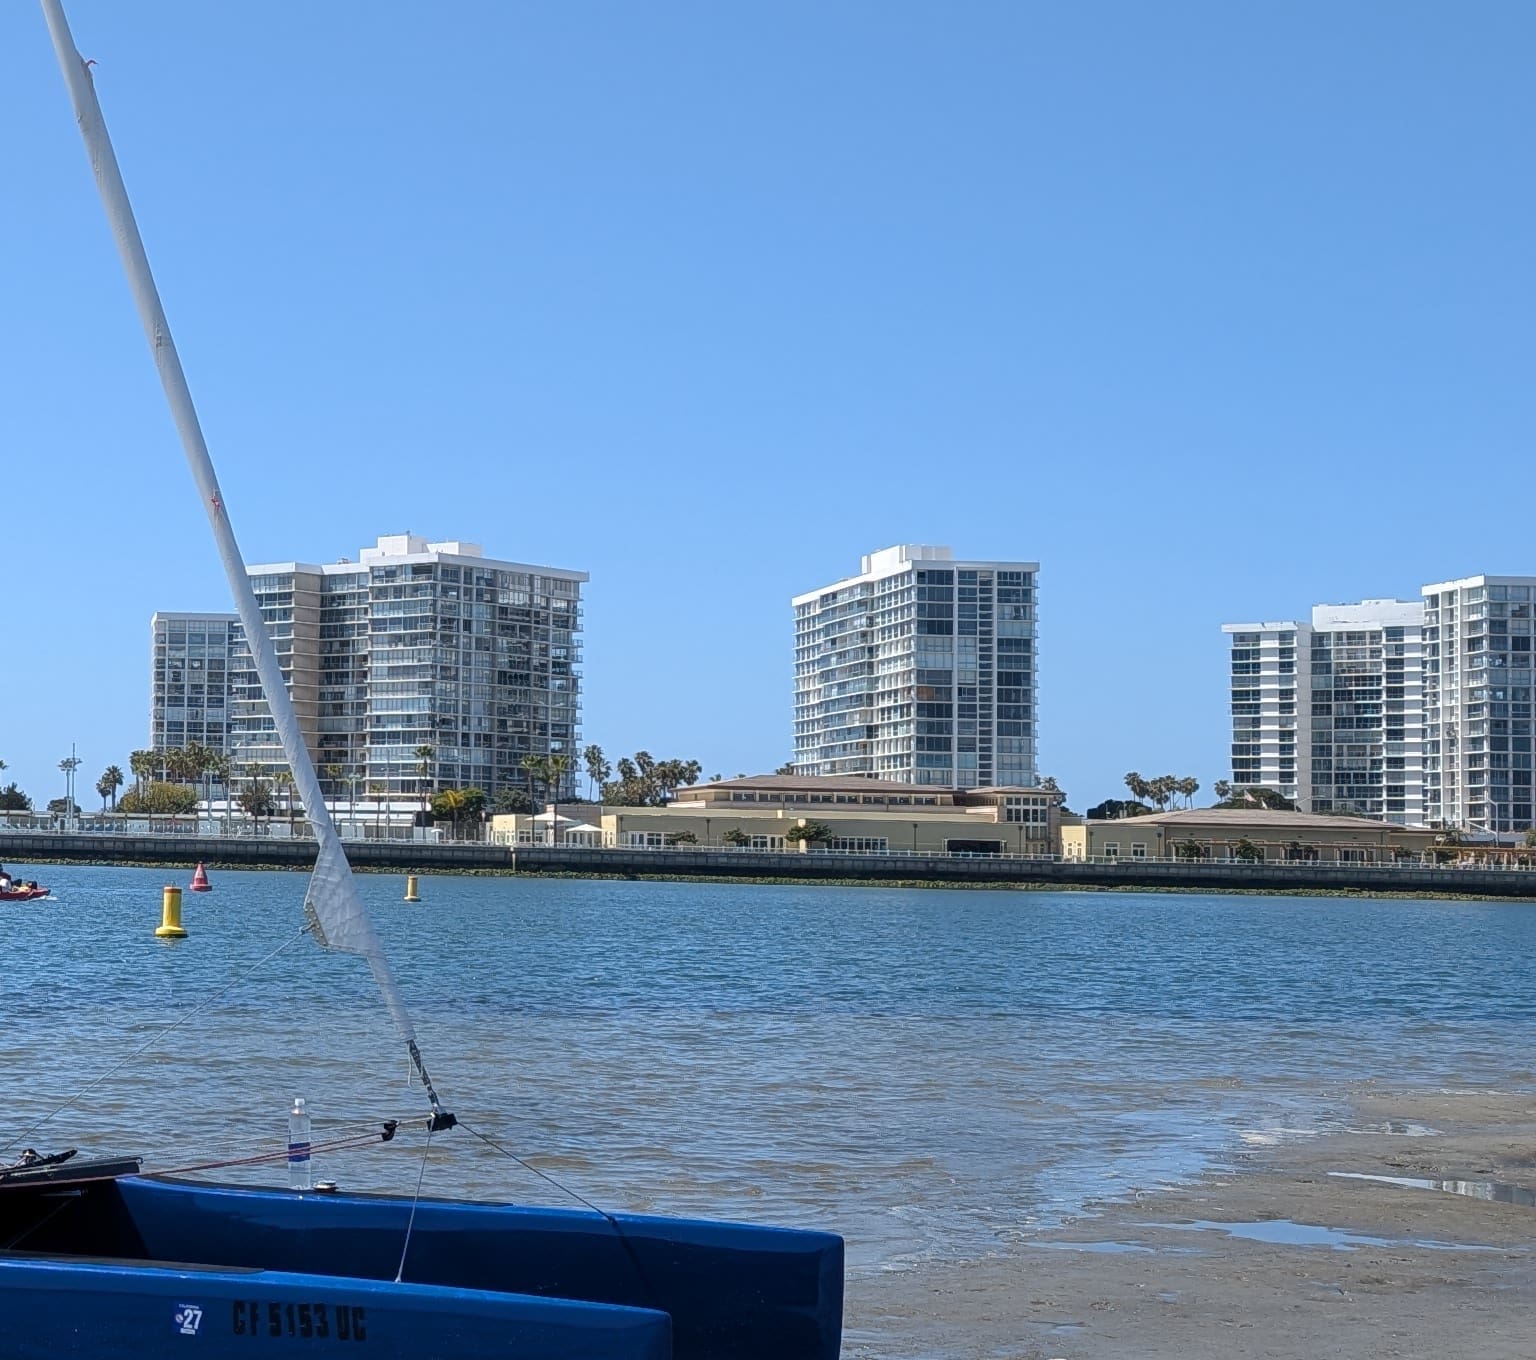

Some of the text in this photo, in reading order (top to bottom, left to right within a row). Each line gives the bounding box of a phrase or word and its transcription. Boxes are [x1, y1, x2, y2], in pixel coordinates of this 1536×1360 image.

[183, 1308, 203, 1330] 27
[232, 1300, 259, 1337] CF
[268, 1302, 329, 1338] 5153
